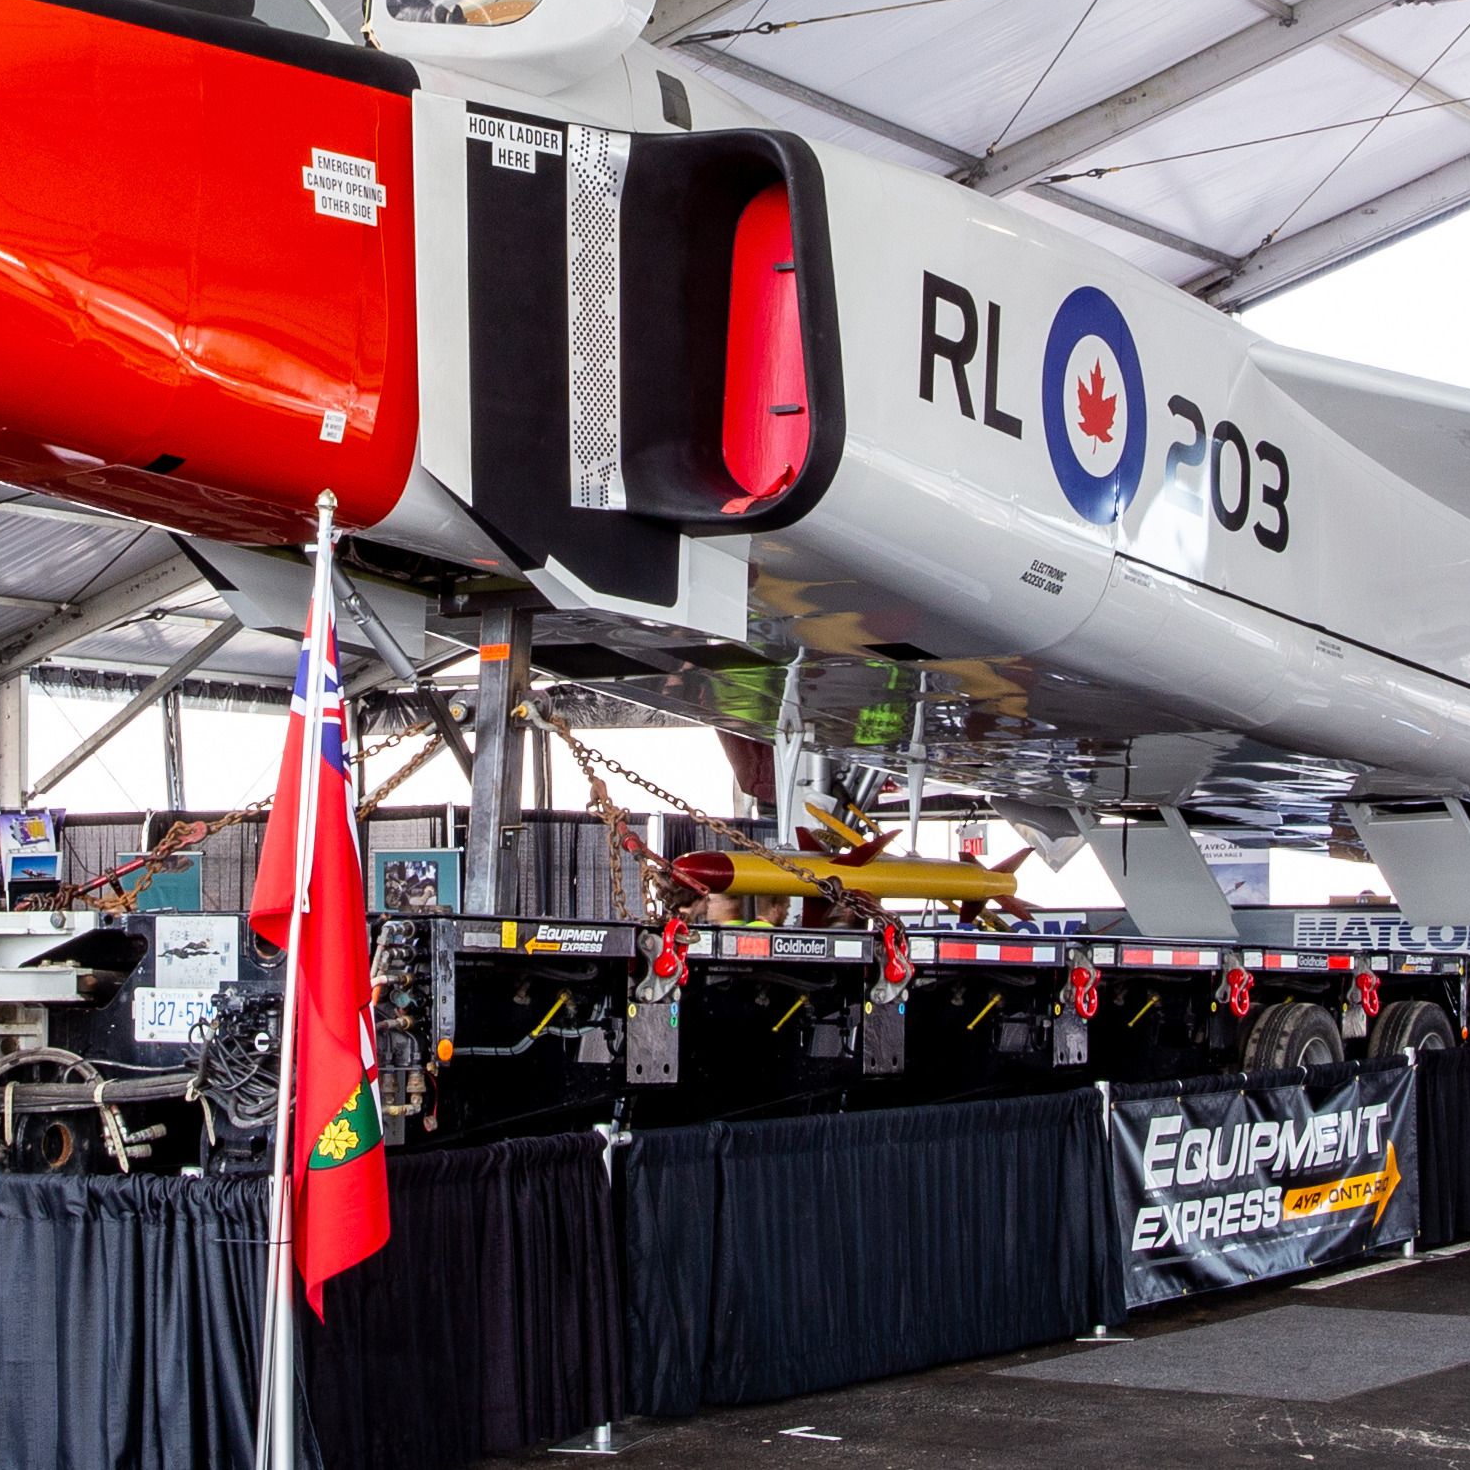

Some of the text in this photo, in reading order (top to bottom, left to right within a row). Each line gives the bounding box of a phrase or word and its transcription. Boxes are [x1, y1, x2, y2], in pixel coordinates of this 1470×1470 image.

[469, 116, 558, 150] HOOK LADDER
[317, 155, 372, 180] EMERGENCY
[498, 148, 530, 169] HERE
[307, 172, 383, 203] CANOPY OPENING
[321, 195, 372, 220] OTHER SIDE
[919, 269, 1291, 554] RL 203
[1030, 559, 1068, 582] ELECTRONIC
[1019, 571, 1064, 596] ACCESS DOOR
[963, 837, 984, 855] EXIT
[1204, 843, 1227, 851] AVRO
[536, 925, 608, 942] EQUIPMENT
[774, 936, 826, 955] Goldhofer
[560, 942, 603, 953] EXPRESS
[148, 1001, 176, 1027] J27
[1142, 1102, 1389, 1190] EQUIPMENT
[1131, 1186, 1283, 1252] EXPRESS
